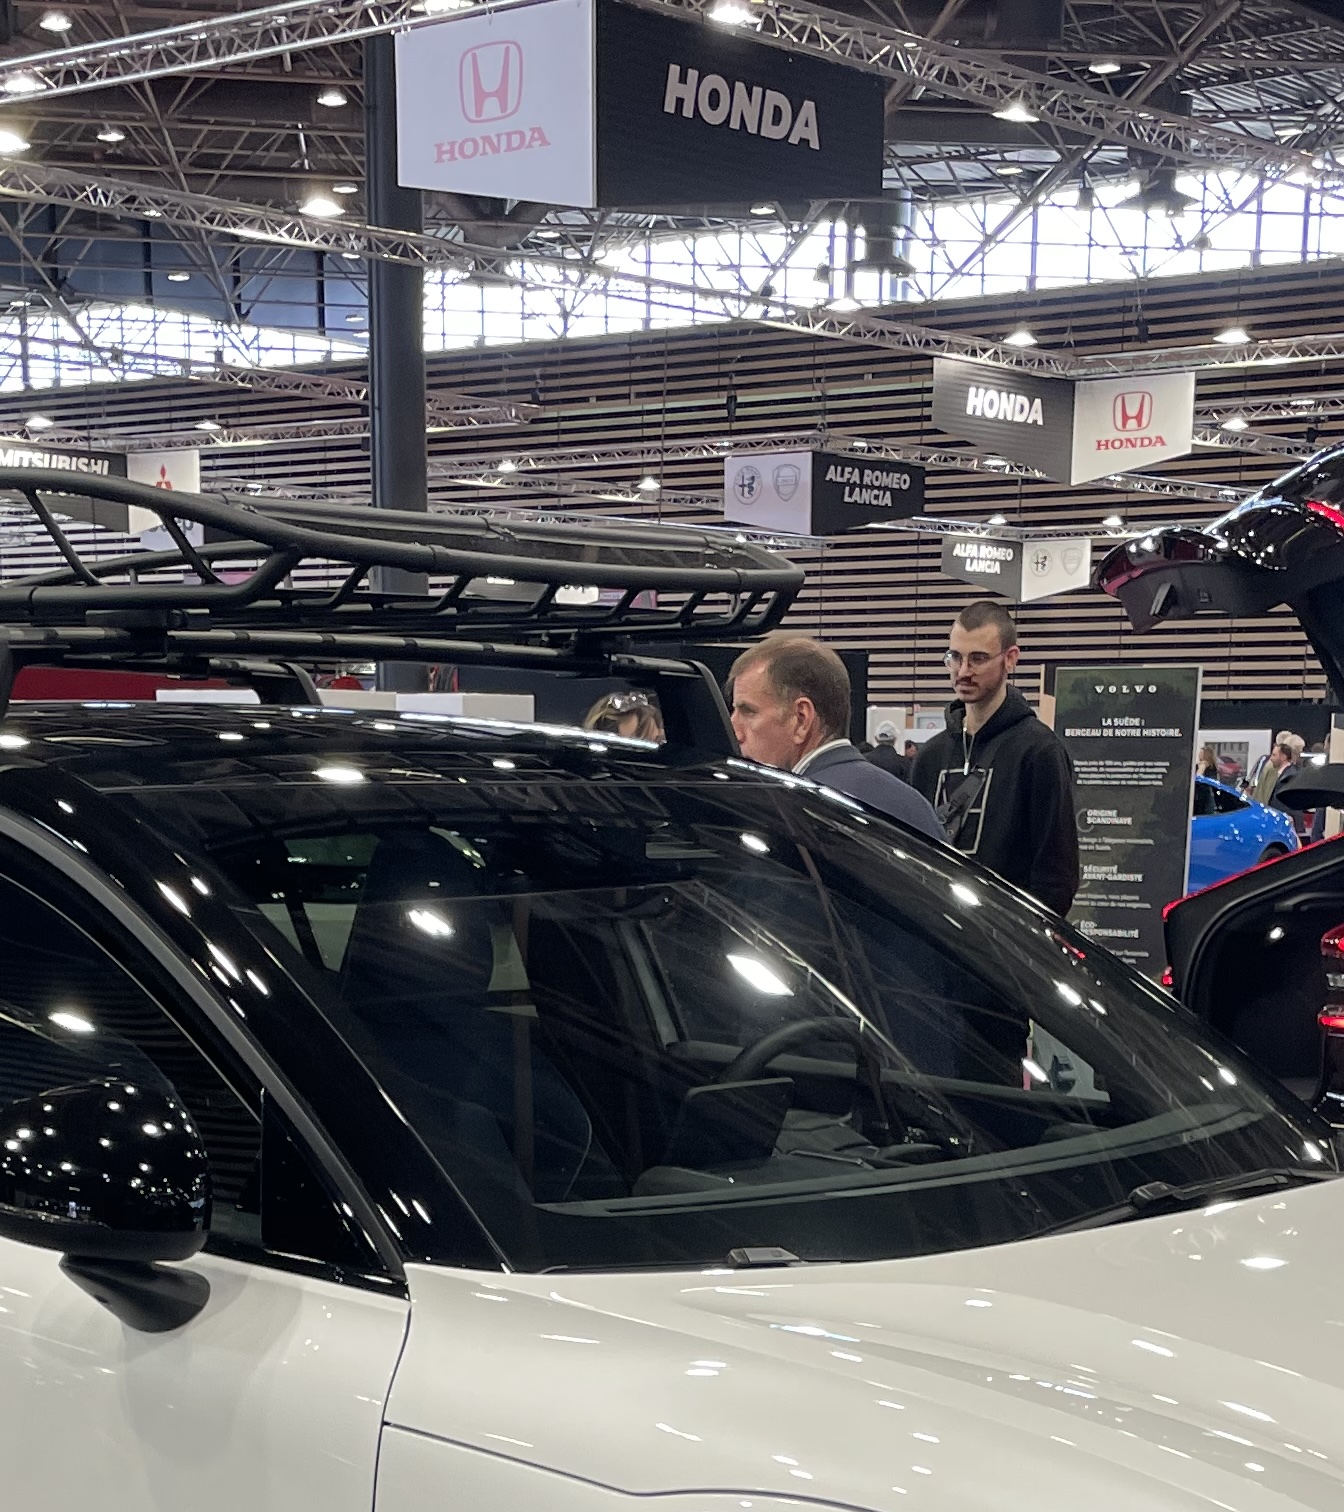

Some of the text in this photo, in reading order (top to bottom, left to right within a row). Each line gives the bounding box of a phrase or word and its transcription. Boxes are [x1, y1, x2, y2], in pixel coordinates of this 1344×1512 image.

[663, 62, 821, 151] HONDA
[433, 126, 552, 165] HONDA
[965, 385, 1045, 427] HONDA
[1095, 435, 1168, 451] HONDA
[825, 464, 911, 491] ALFA ROMEO
[843, 485, 893, 508] LANCIA
[952, 543, 1014, 561] ALFA ROMEO
[965, 558, 1001, 575] LANCIA
[1094, 684, 1157, 694] VOLVO
[1101, 717, 1112, 727] LA
[1064, 727, 1183, 737] BERCEAU DE NOTRE HISTOIRE.
